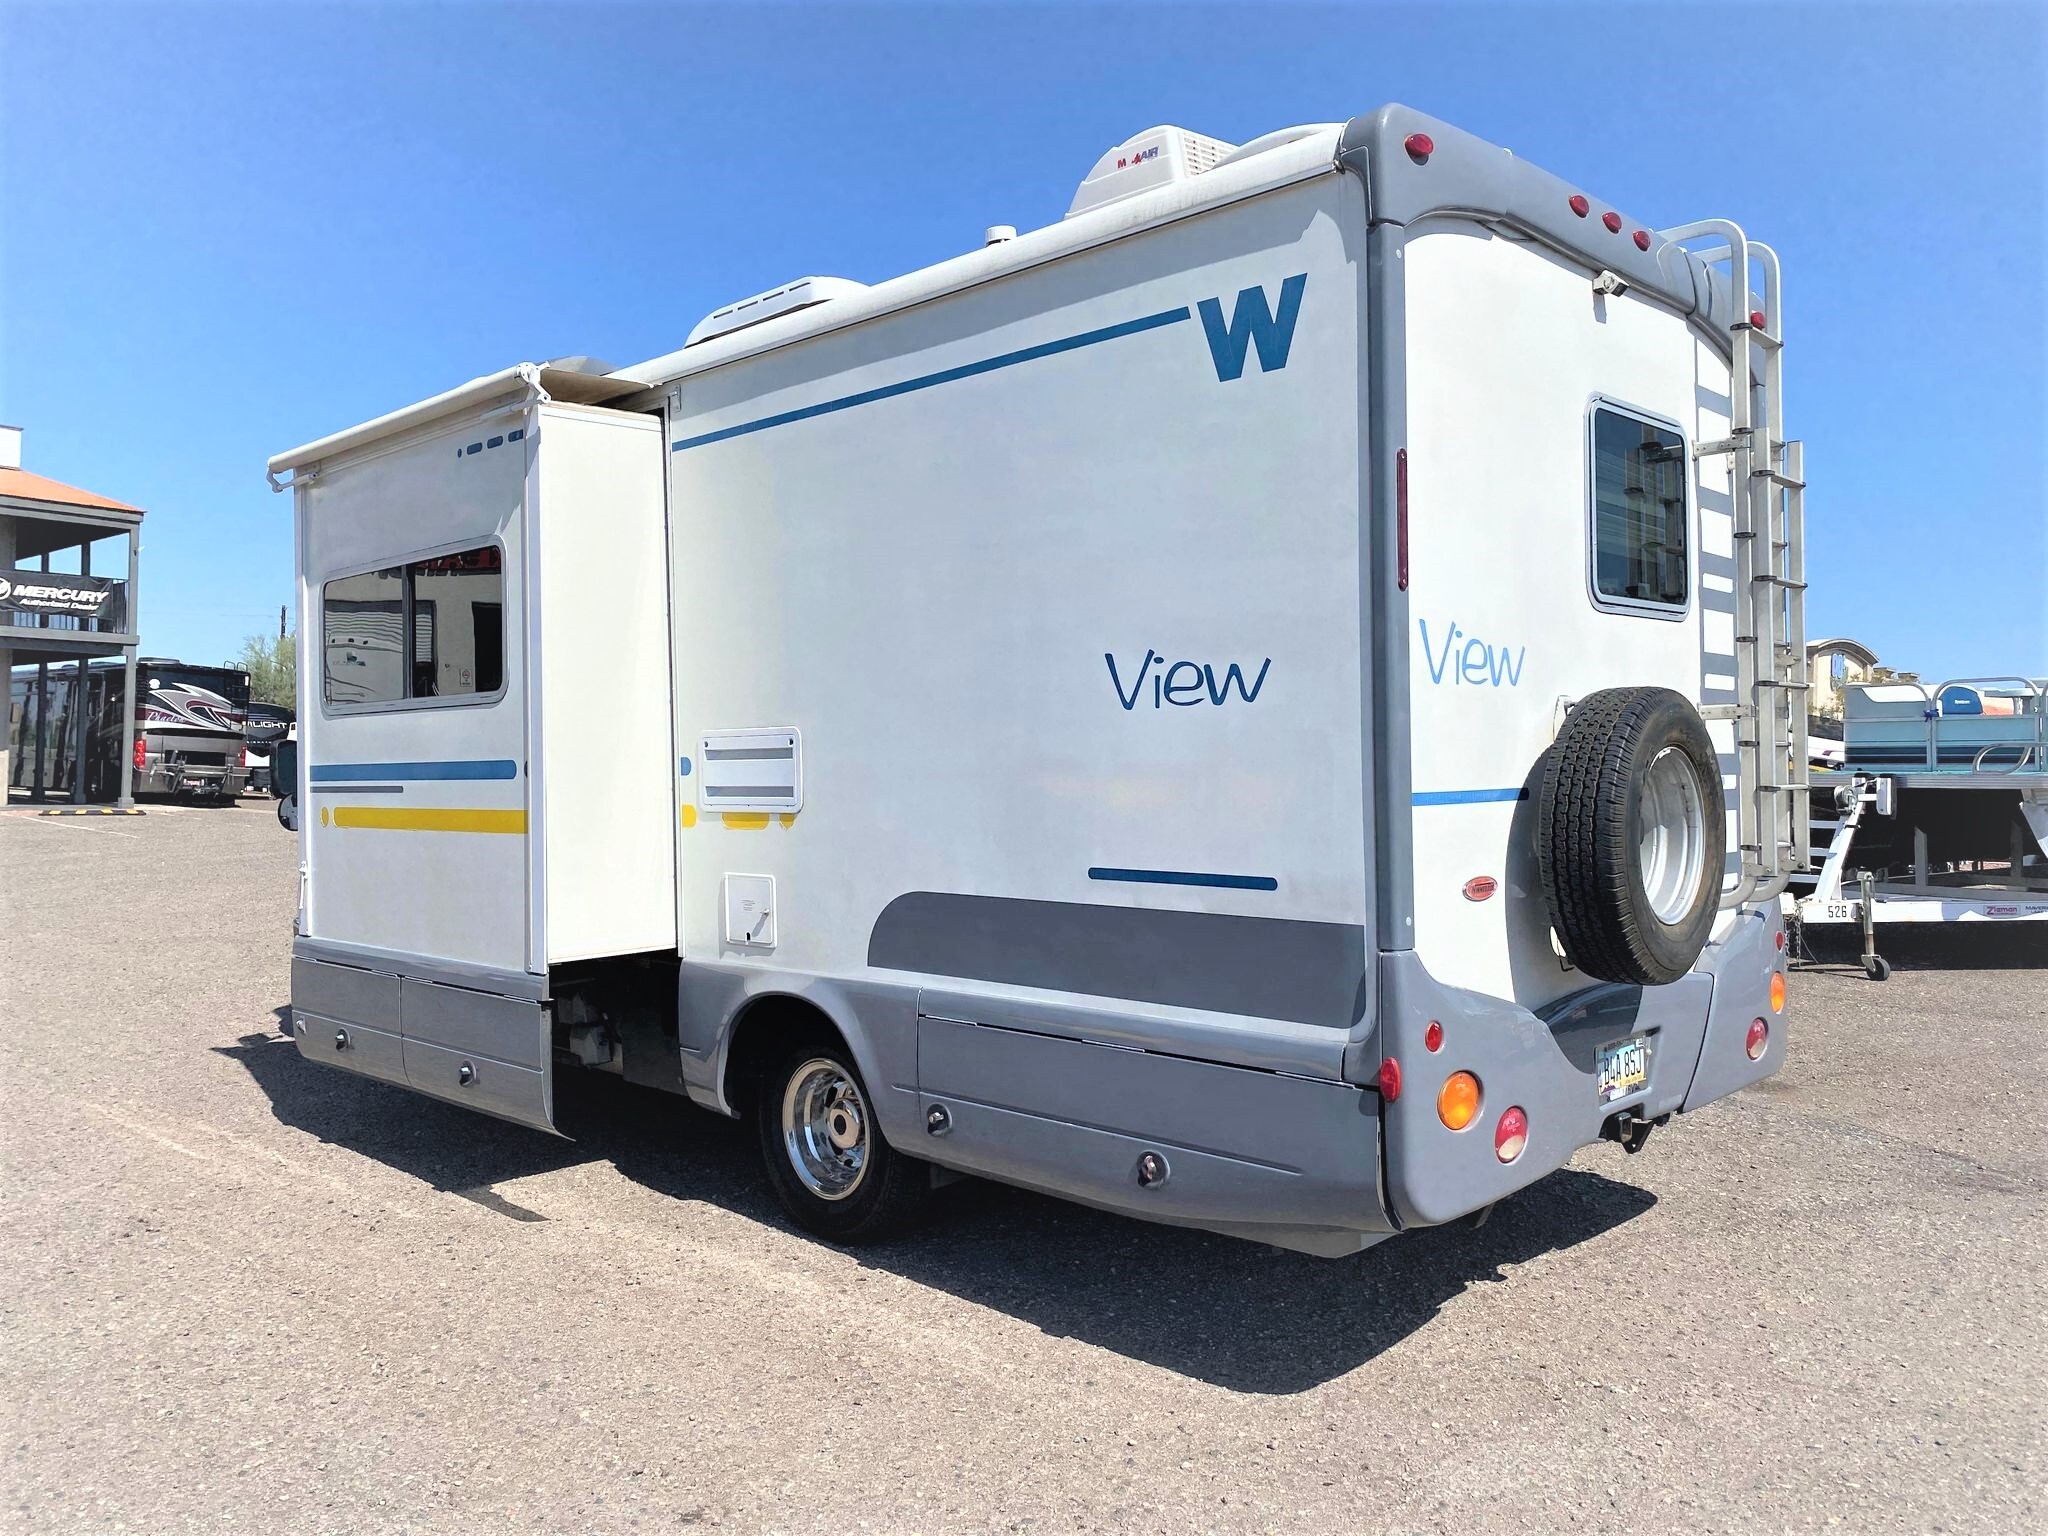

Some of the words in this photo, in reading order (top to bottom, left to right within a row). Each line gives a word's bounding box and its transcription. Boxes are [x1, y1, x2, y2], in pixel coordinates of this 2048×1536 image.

[1197, 272, 1308, 383] W
[12, 584, 110, 603] MERCURY
[19, 598, 71, 608] Authorized
[1418, 618, 1526, 688] View
[1104, 648, 1272, 711] View
[1827, 905, 1847, 918] 526
